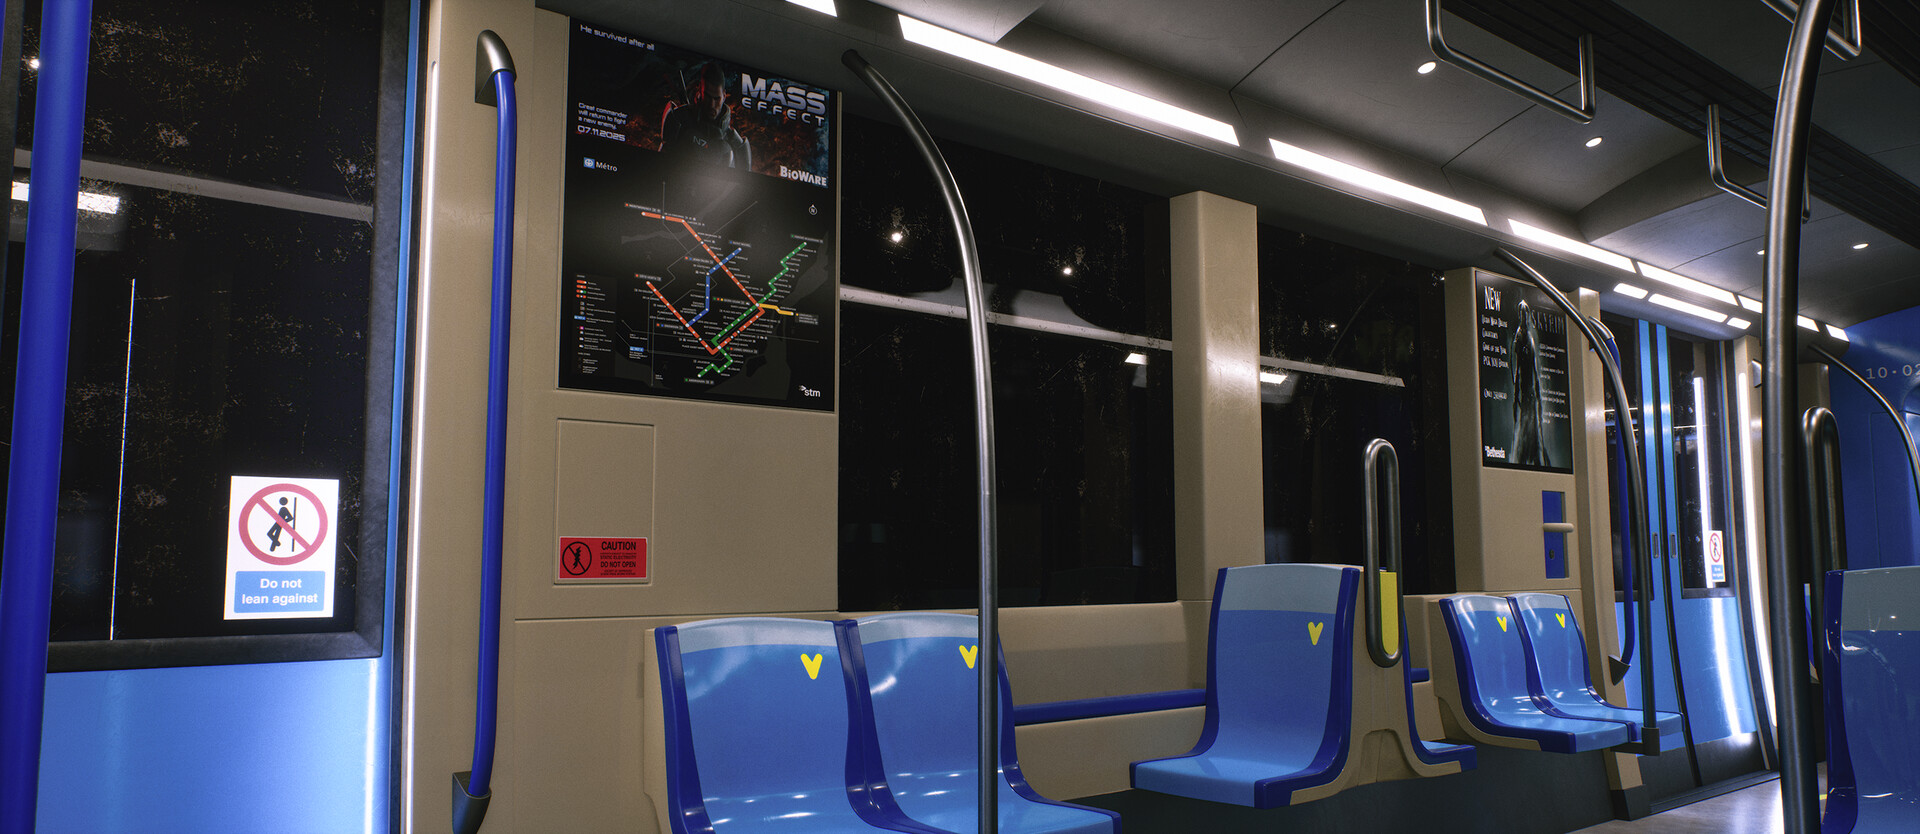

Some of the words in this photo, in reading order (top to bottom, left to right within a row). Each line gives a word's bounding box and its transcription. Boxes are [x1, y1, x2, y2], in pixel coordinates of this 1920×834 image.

[580, 24, 592, 35] He
[594, 29, 627, 44] survived
[628, 38, 645, 48] after
[646, 43, 655, 51] all
[742, 73, 826, 116] MASS
[578, 102, 595, 112] Great
[596, 107, 627, 119] commander
[589, 112, 606, 121] return
[742, 97, 825, 127] EFFECT
[577, 124, 626, 142] 07.11.2025
[595, 161, 618, 172] Métro
[1484, 285, 1502, 312] NEW
[1531, 309, 1565, 335] SKYRIM
[804, 388, 821, 398] stm
[601, 541, 637, 551] CAUTION
[260, 578, 279, 589] Do
[281, 578, 303, 589] not
[241, 593, 270, 605] lean
[272, 592, 319, 606] against
